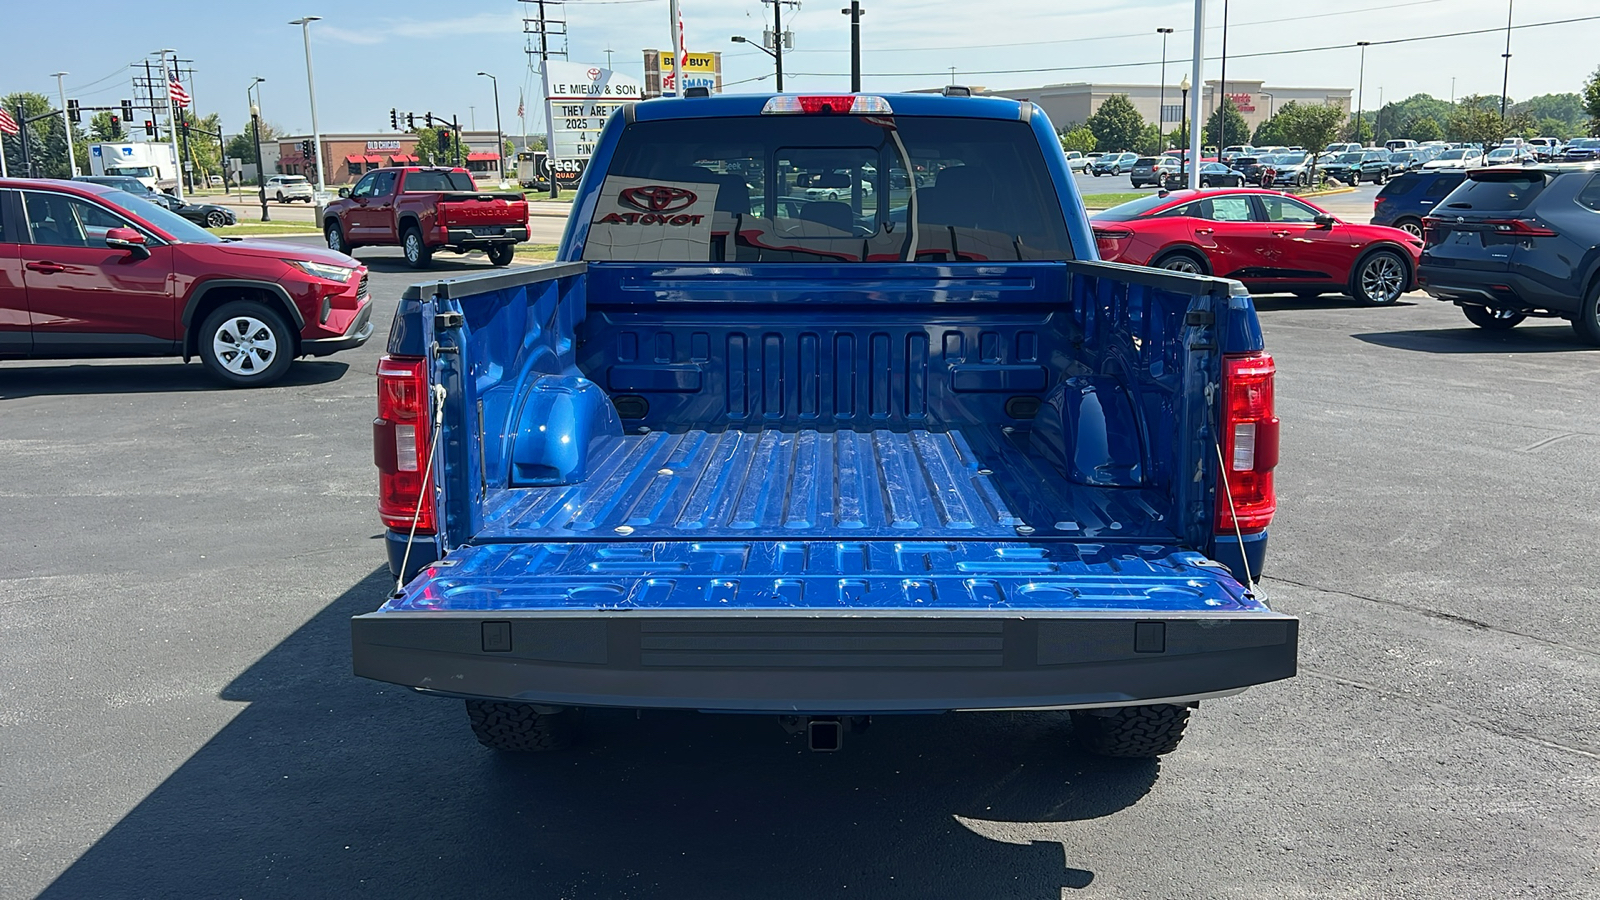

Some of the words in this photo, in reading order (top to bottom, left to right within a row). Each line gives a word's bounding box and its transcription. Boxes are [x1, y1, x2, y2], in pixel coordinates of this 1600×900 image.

[690, 58, 711, 67] BUY
[553, 84, 566, 94] LE
[569, 84, 600, 95] MIEUX
[604, 85, 612, 95] &
[615, 84, 636, 95] SON
[663, 77, 714, 91] PESMART
[562, 105, 584, 117] THEY
[590, 106, 607, 117] ARE
[566, 118, 588, 129] 2025
[367, 141, 378, 149] OLD
[463, 208, 509, 217] TUNDRA
